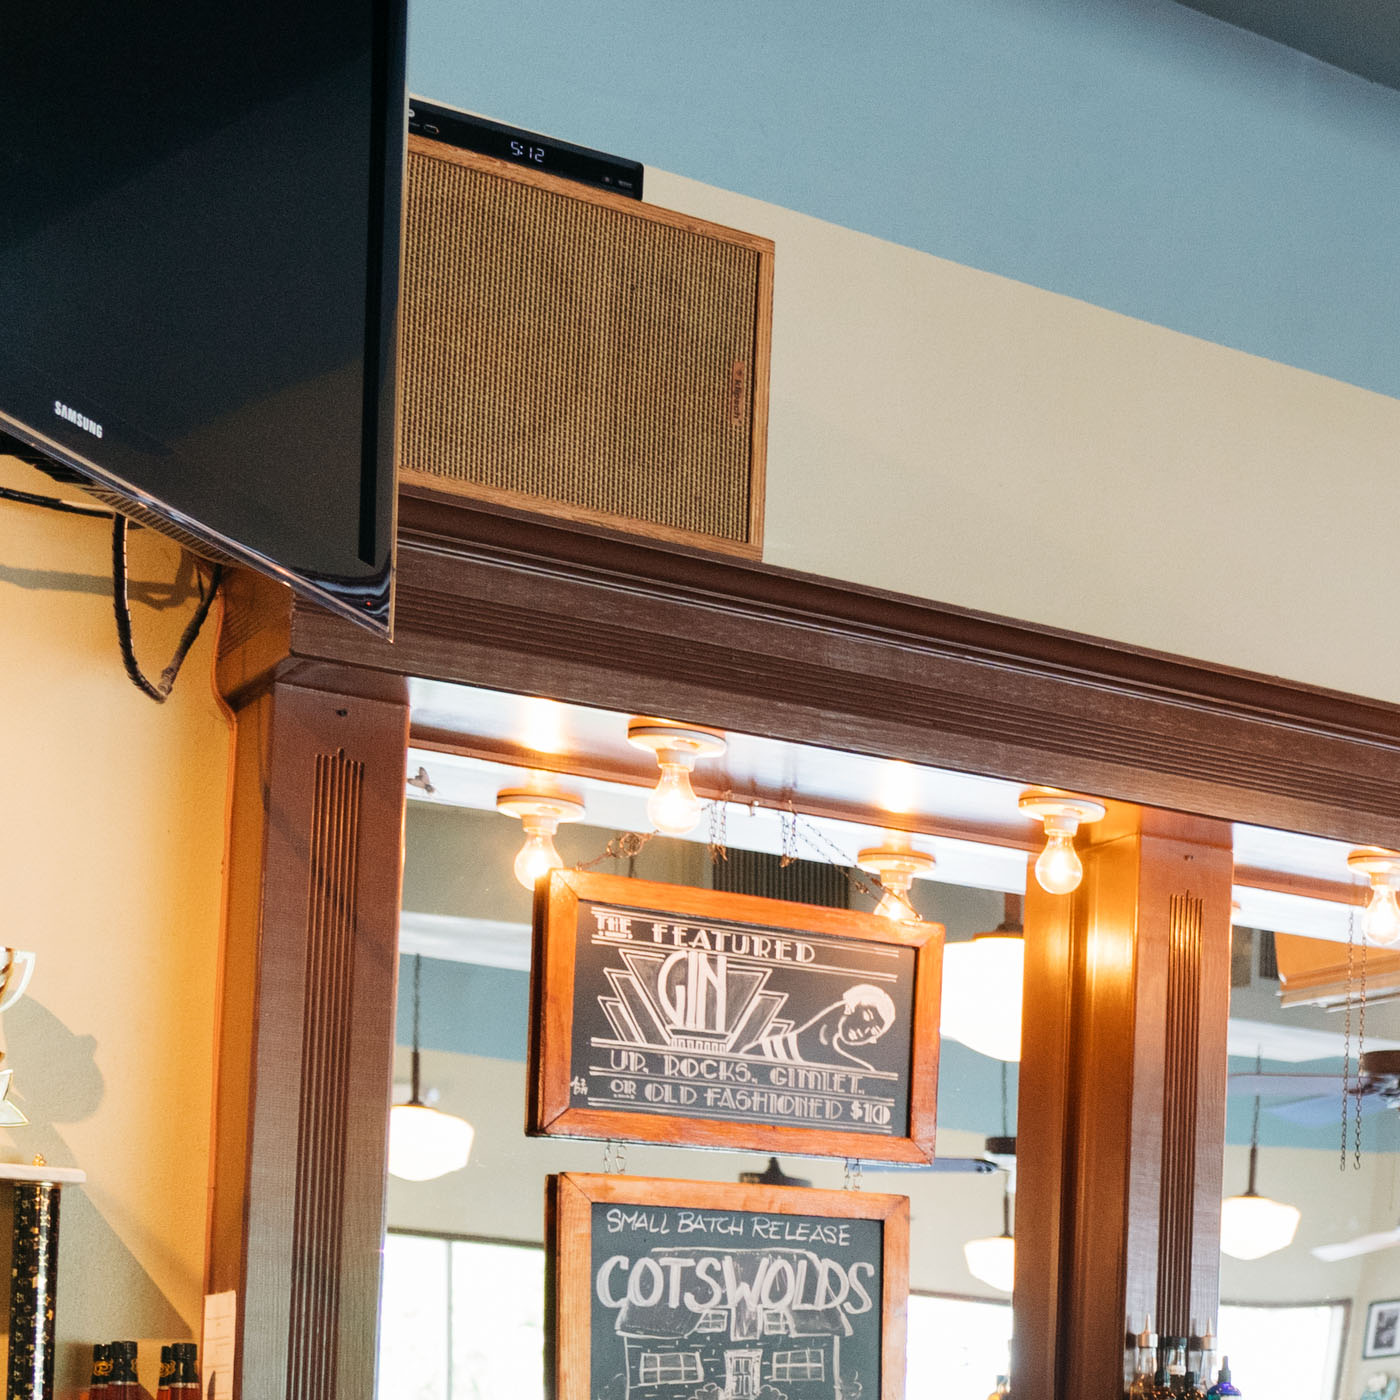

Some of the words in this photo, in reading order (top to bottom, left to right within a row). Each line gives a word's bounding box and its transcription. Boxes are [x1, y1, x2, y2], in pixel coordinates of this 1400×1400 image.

[510, 140, 545, 163] 5:12
[54, 400, 103, 439] SAMSUNG
[594, 911, 633, 934] THE
[652, 923, 816, 964] FEATURED
[657, 949, 728, 1033] GIN
[610, 1079, 637, 1095] OR
[645, 1082, 697, 1106] OLD
[703, 1087, 843, 1121] FASHIONED
[849, 1101, 891, 1126] $10
[606, 1208, 671, 1235] SMALL
[677, 1211, 744, 1237] BATCH
[752, 1216, 851, 1247] RELEASE
[596, 1255, 876, 1315] COTSWOLDS
